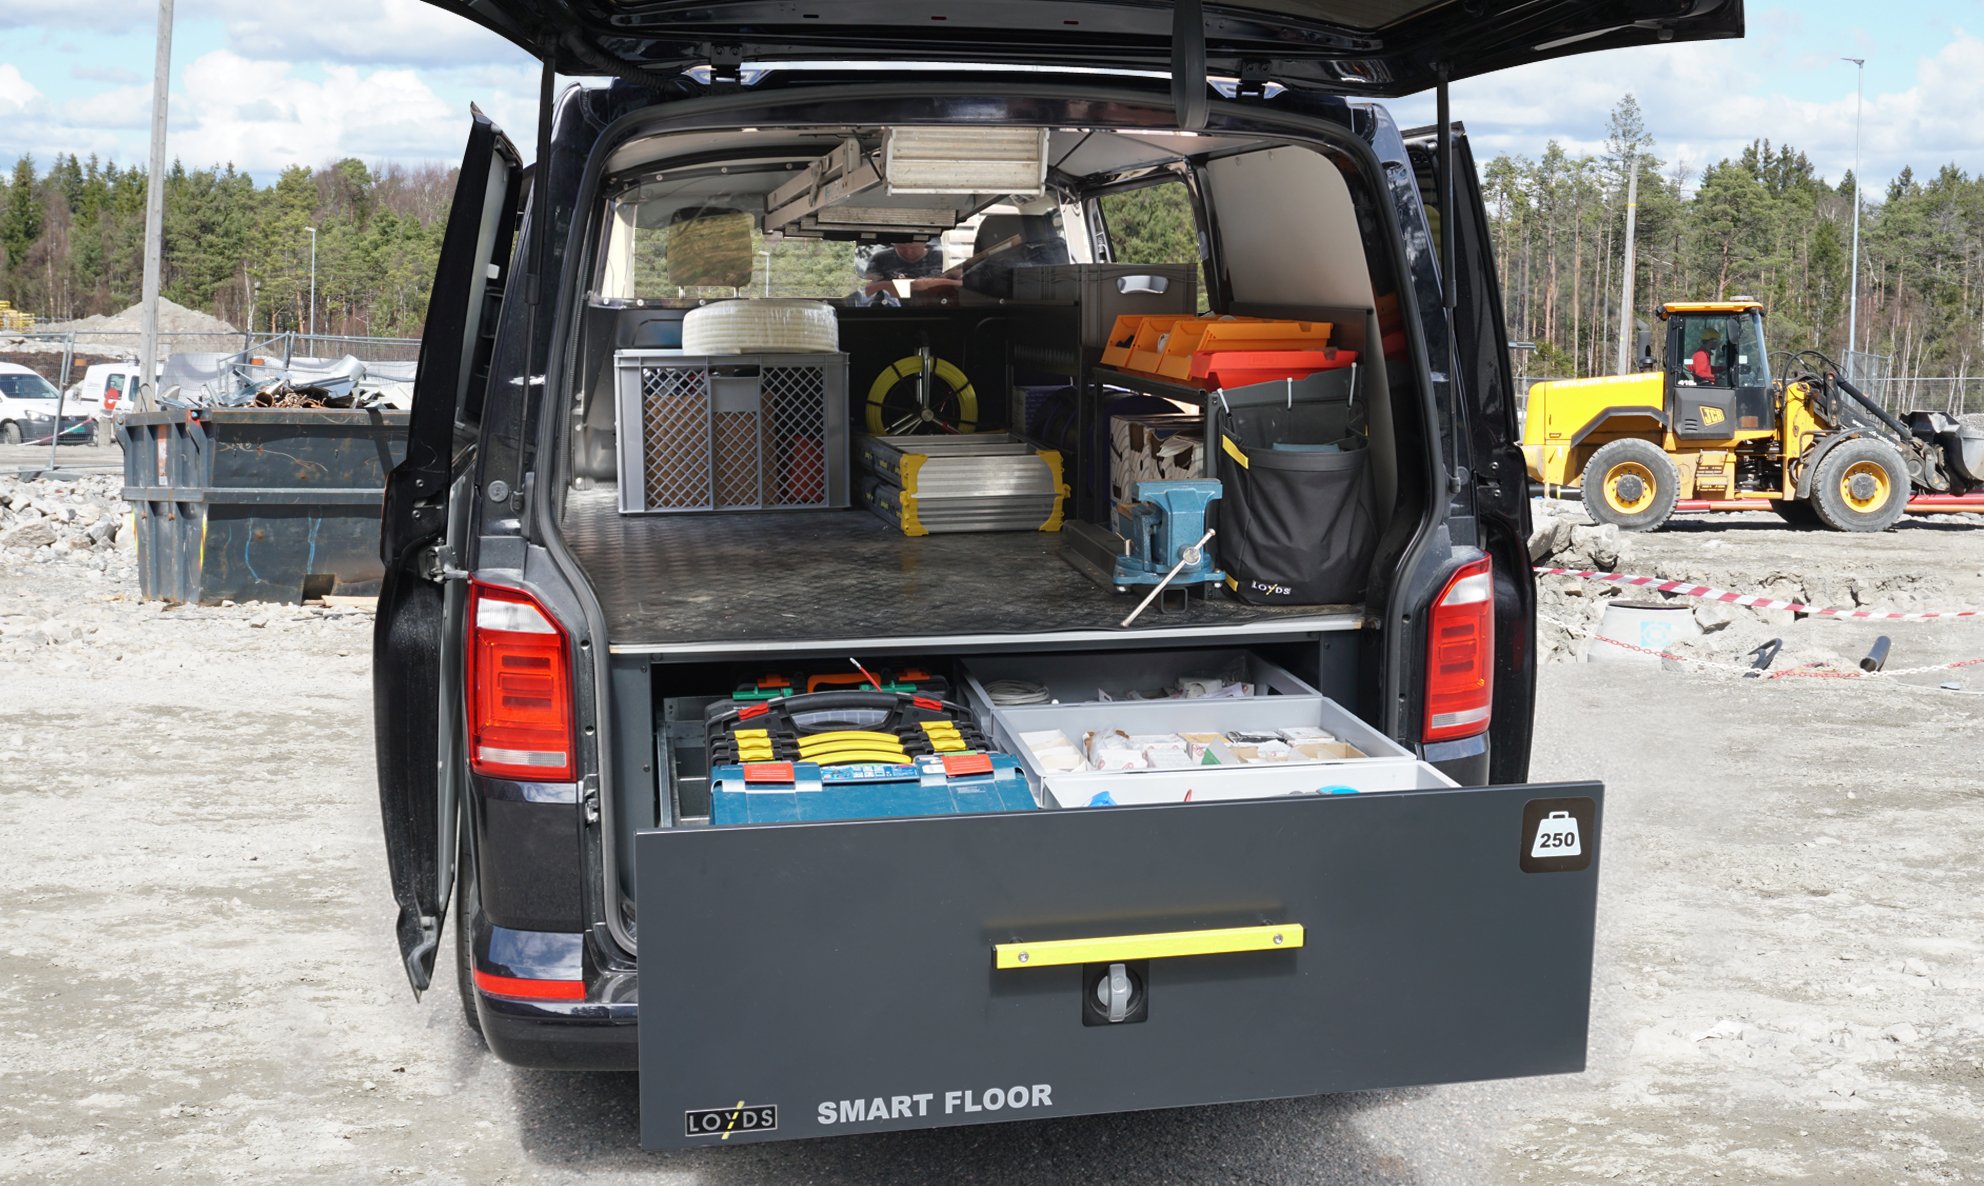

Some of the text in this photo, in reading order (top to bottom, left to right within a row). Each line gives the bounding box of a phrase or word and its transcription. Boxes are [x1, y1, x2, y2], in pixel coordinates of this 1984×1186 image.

[1702, 409, 1725, 424] JCB
[1251, 580, 1291, 595] LOYDS
[1540, 832, 1576, 848] 250
[817, 1084, 1053, 1125] SMART FLOOR
[688, 1105, 774, 1135] LOYDS
